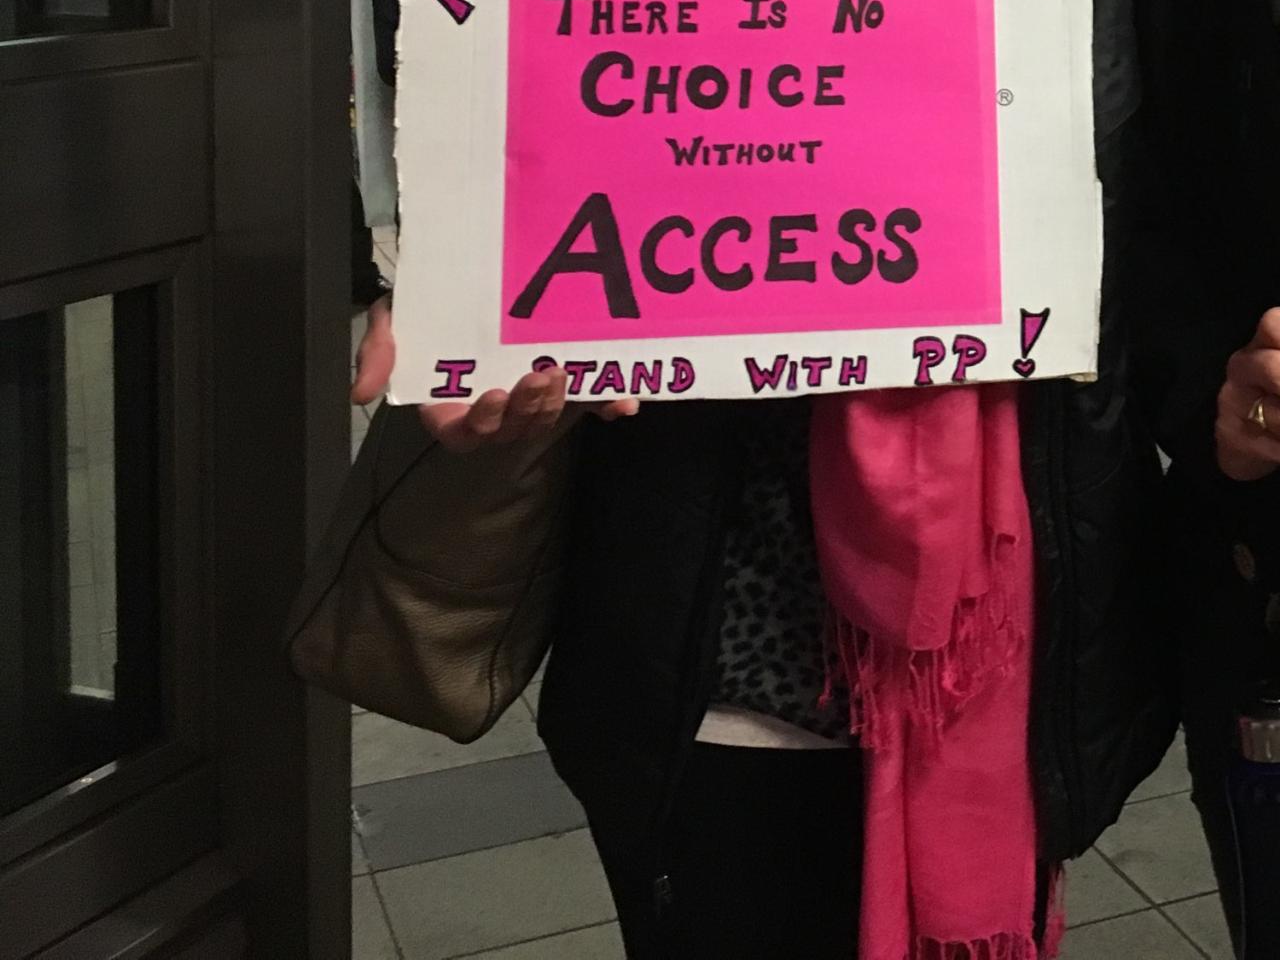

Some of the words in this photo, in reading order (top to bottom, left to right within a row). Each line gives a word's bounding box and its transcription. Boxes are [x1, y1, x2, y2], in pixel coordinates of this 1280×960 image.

[579, 50, 846, 118] CHOICE
[665, 136, 823, 168] WITHOUT
[507, 191, 922, 320] ACCESS
[430, 359, 477, 398] I
[744, 353, 868, 394] WITH
